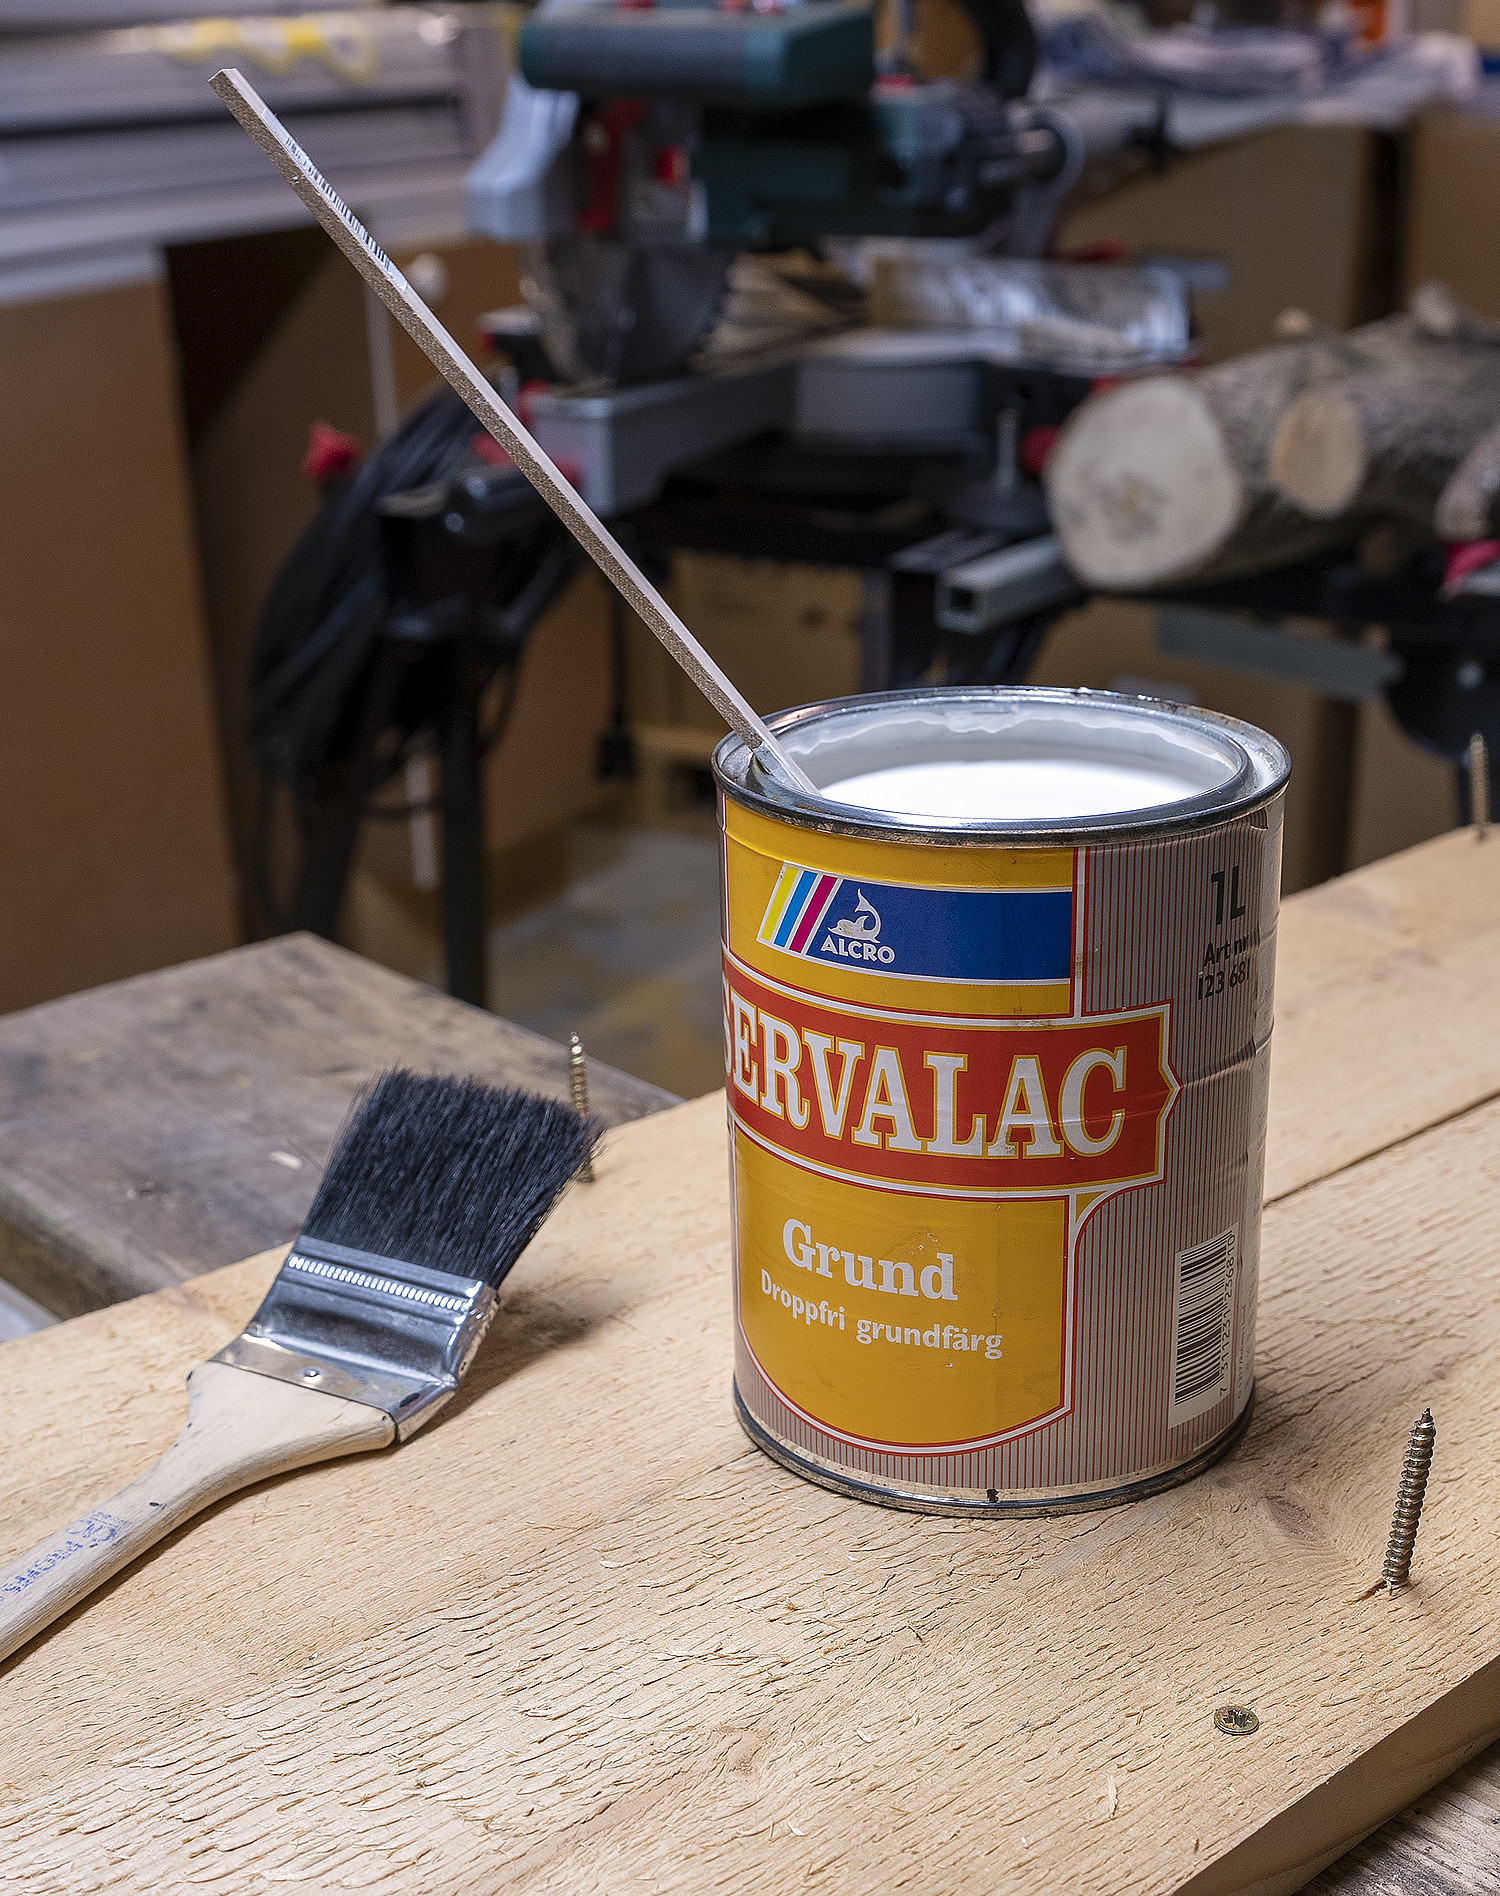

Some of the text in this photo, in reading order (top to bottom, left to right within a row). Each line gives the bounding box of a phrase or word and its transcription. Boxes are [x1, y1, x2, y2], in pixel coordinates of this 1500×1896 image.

[1210, 865, 1246, 926] 1L
[820, 934, 896, 964] ALCRO
[1203, 934, 1250, 967] Art nr
[782, 1218, 958, 1301] Grund
[761, 1268, 1003, 1360] Droppfri grundfärg
